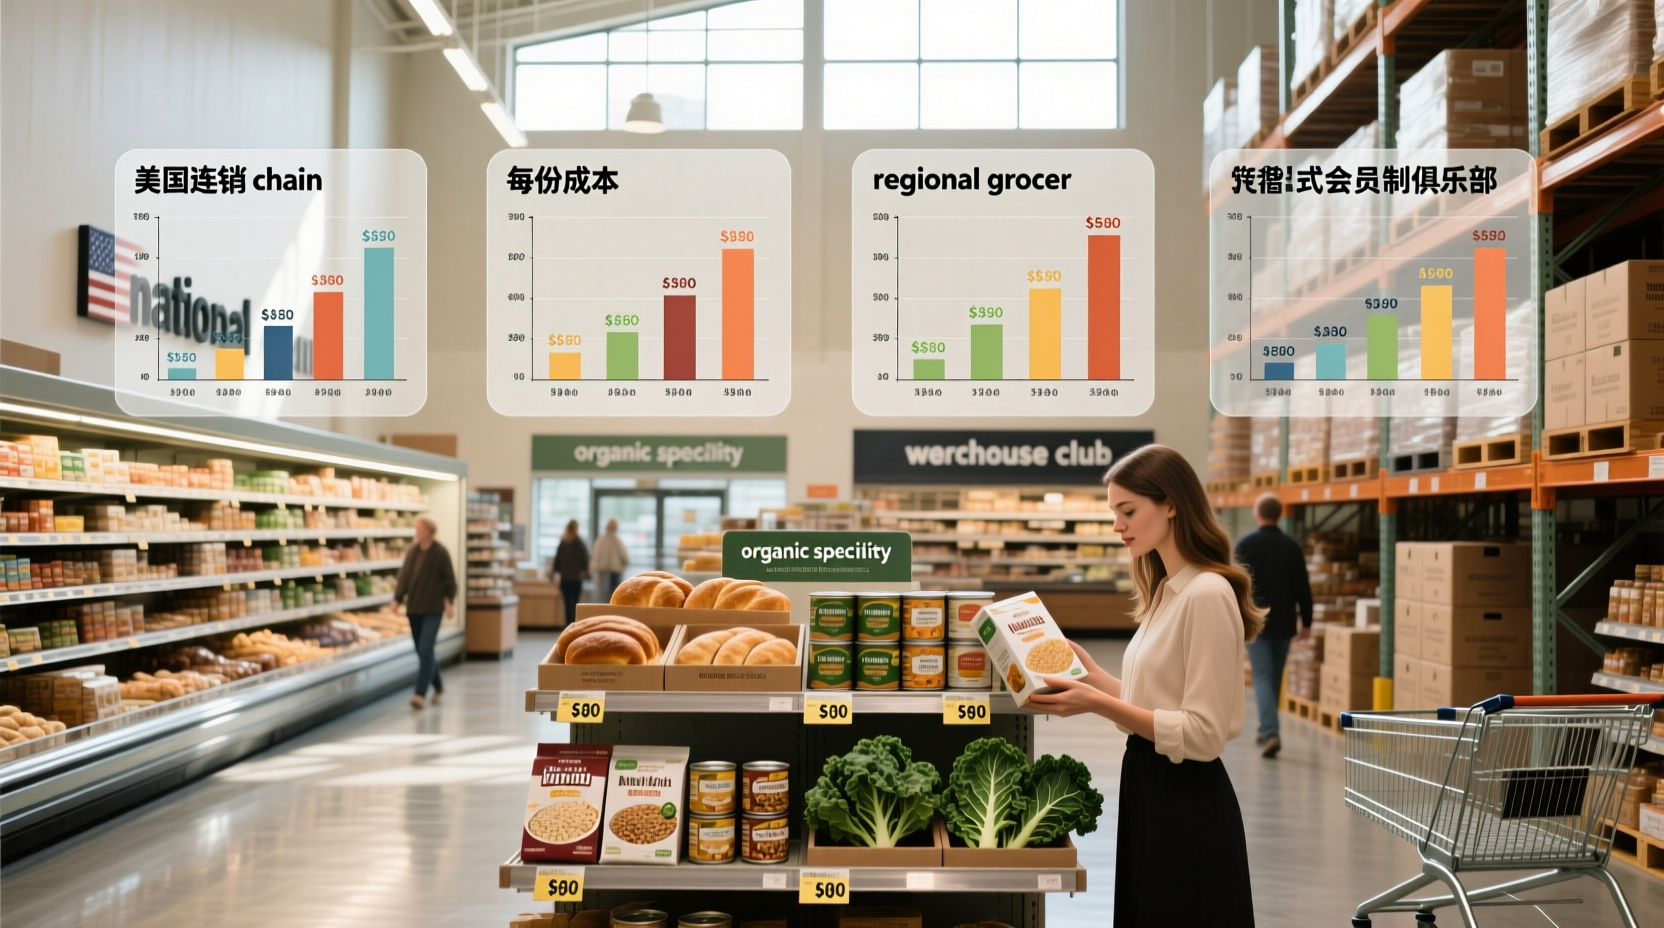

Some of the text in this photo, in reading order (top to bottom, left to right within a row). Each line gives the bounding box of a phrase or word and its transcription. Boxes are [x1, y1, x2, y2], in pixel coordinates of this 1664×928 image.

[130, 273, 251, 355] national
[574, 441, 651, 468] organic
[905, 438, 1112, 467] werchouse club
[741, 541, 810, 564] organic
